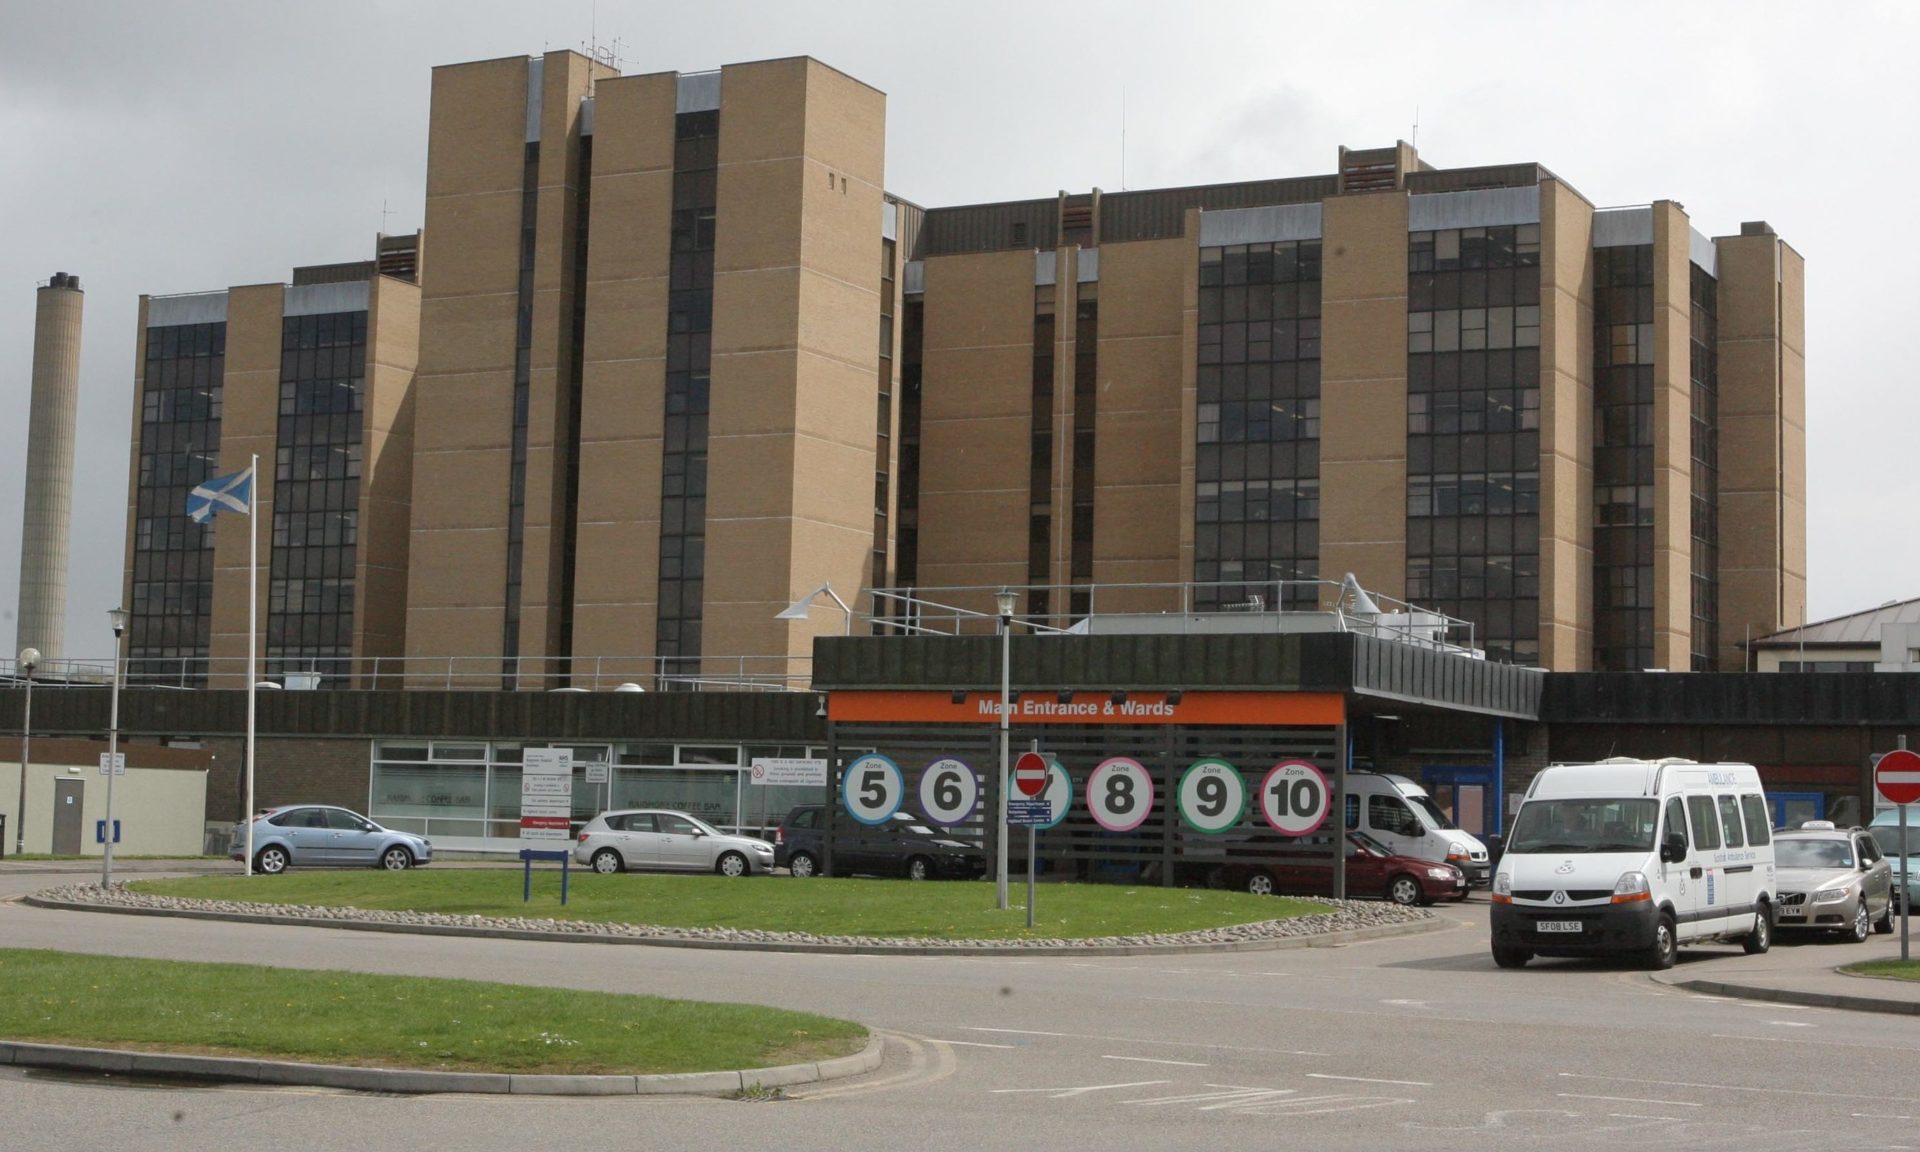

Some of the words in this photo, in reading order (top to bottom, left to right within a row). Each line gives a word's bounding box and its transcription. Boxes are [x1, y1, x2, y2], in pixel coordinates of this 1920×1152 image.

[978, 699, 1018, 715] Man
[1023, 700, 1098, 715] Entrance
[1102, 700, 1115, 715] &
[1120, 701, 1174, 715] Wards
[940, 762, 957, 770] Zone
[1202, 766, 1221, 774] Zone
[1284, 768, 1305, 776] Zone
[859, 771, 887, 809] 5
[933, 771, 962, 811] 6
[1104, 774, 1135, 814] 8
[1196, 775, 1228, 817] 9
[1270, 778, 1321, 818] 10
[1562, 922, 1580, 931] LSE
